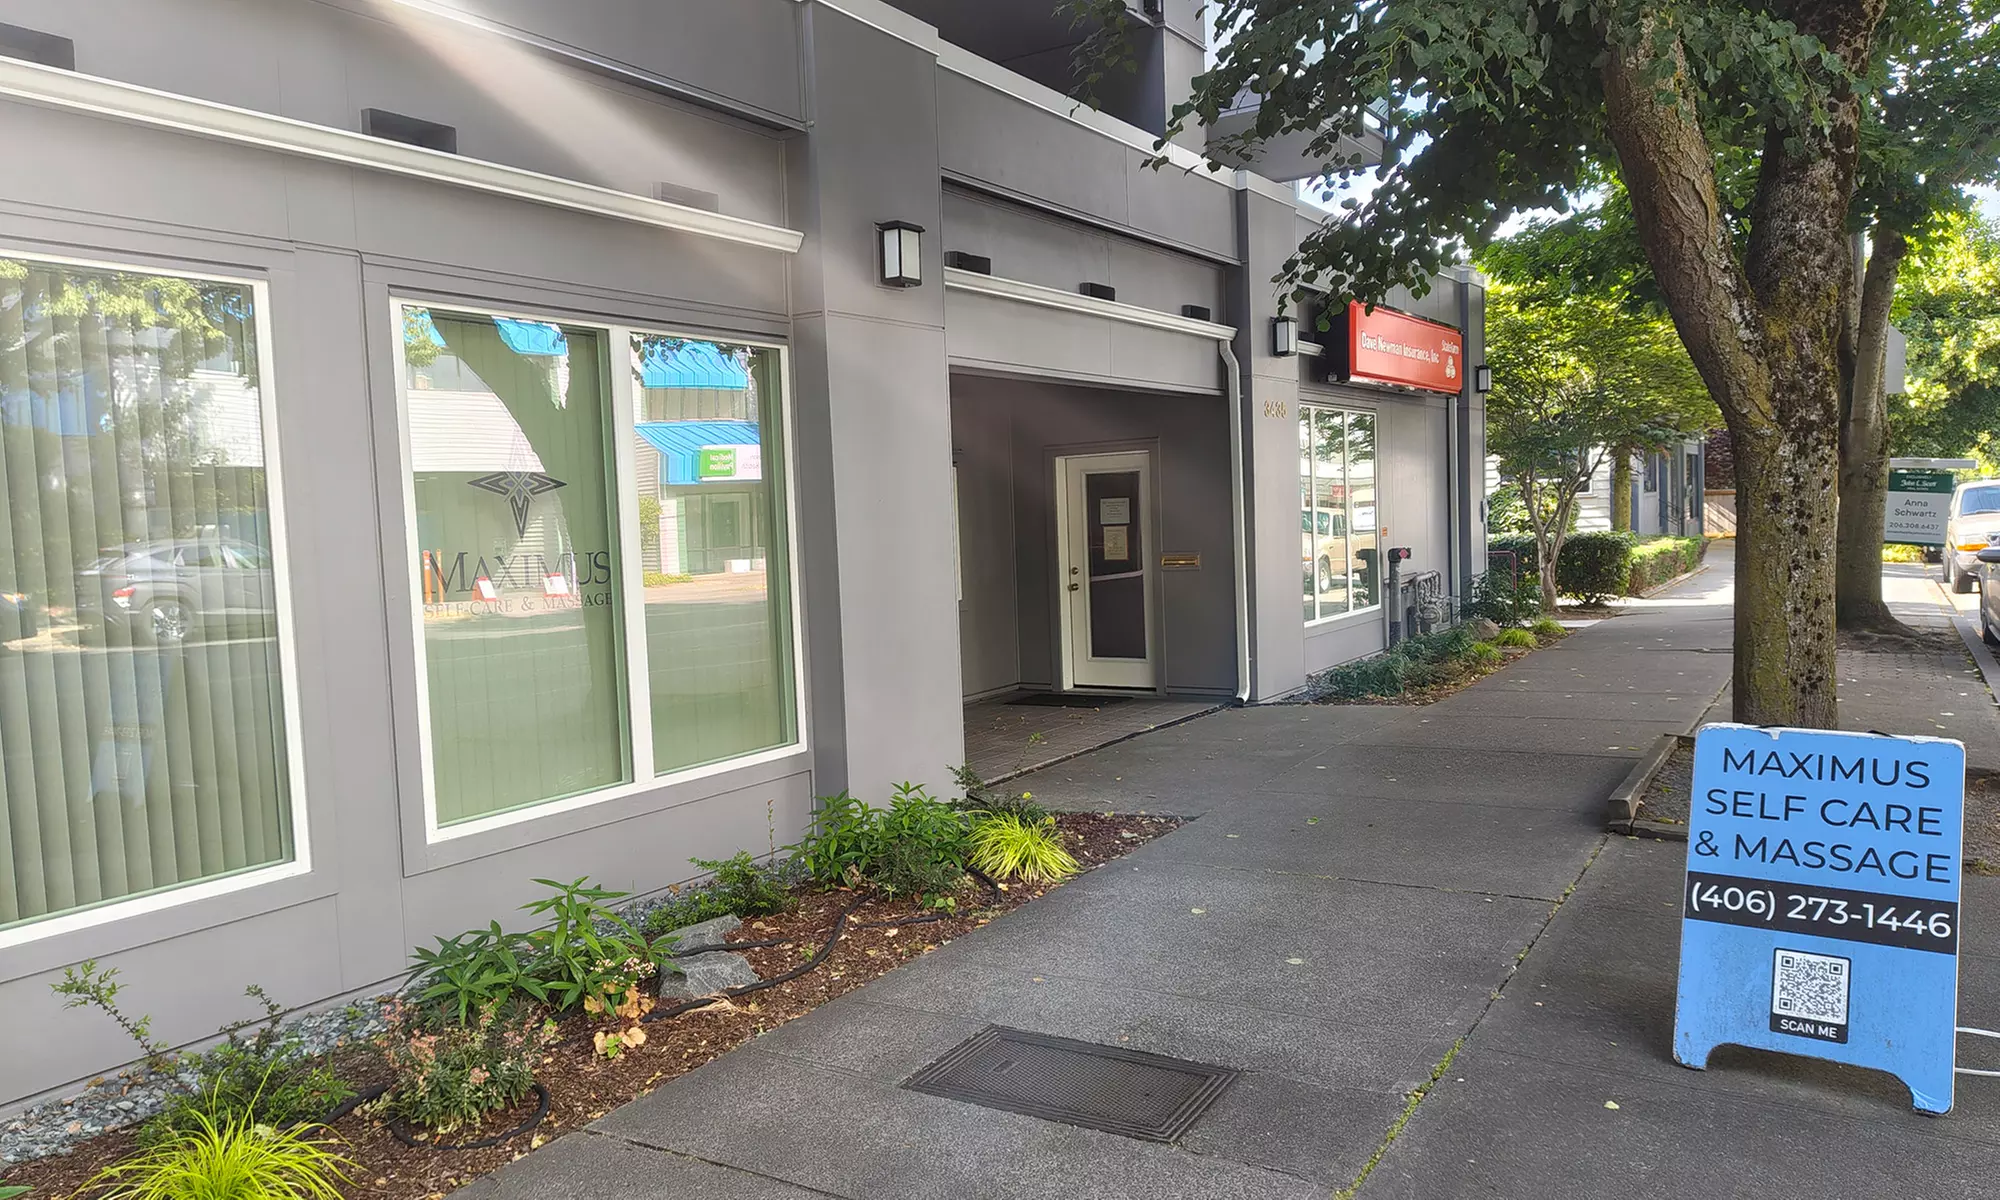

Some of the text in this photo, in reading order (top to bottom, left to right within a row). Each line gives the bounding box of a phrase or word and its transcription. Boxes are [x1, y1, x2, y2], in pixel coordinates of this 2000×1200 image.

[1361, 331, 1377, 351] Dave
[1377, 335, 1403, 356] Newman
[1894, 508, 1937, 518] Schwartz
[1904, 499, 1929, 507] Anna
[424, 550, 611, 594] MAXIMUS
[521, 596, 535, 611] &
[542, 592, 612, 610] MASSAGE
[1723, 747, 1931, 789] MAXIMUS
[1705, 788, 1943, 837] SELF CARE
[1694, 830, 1951, 884] & MASSAGE
[1691, 881, 1952, 939] (406) 273-1446
[1780, 1018, 1838, 1039] SCAN ME
